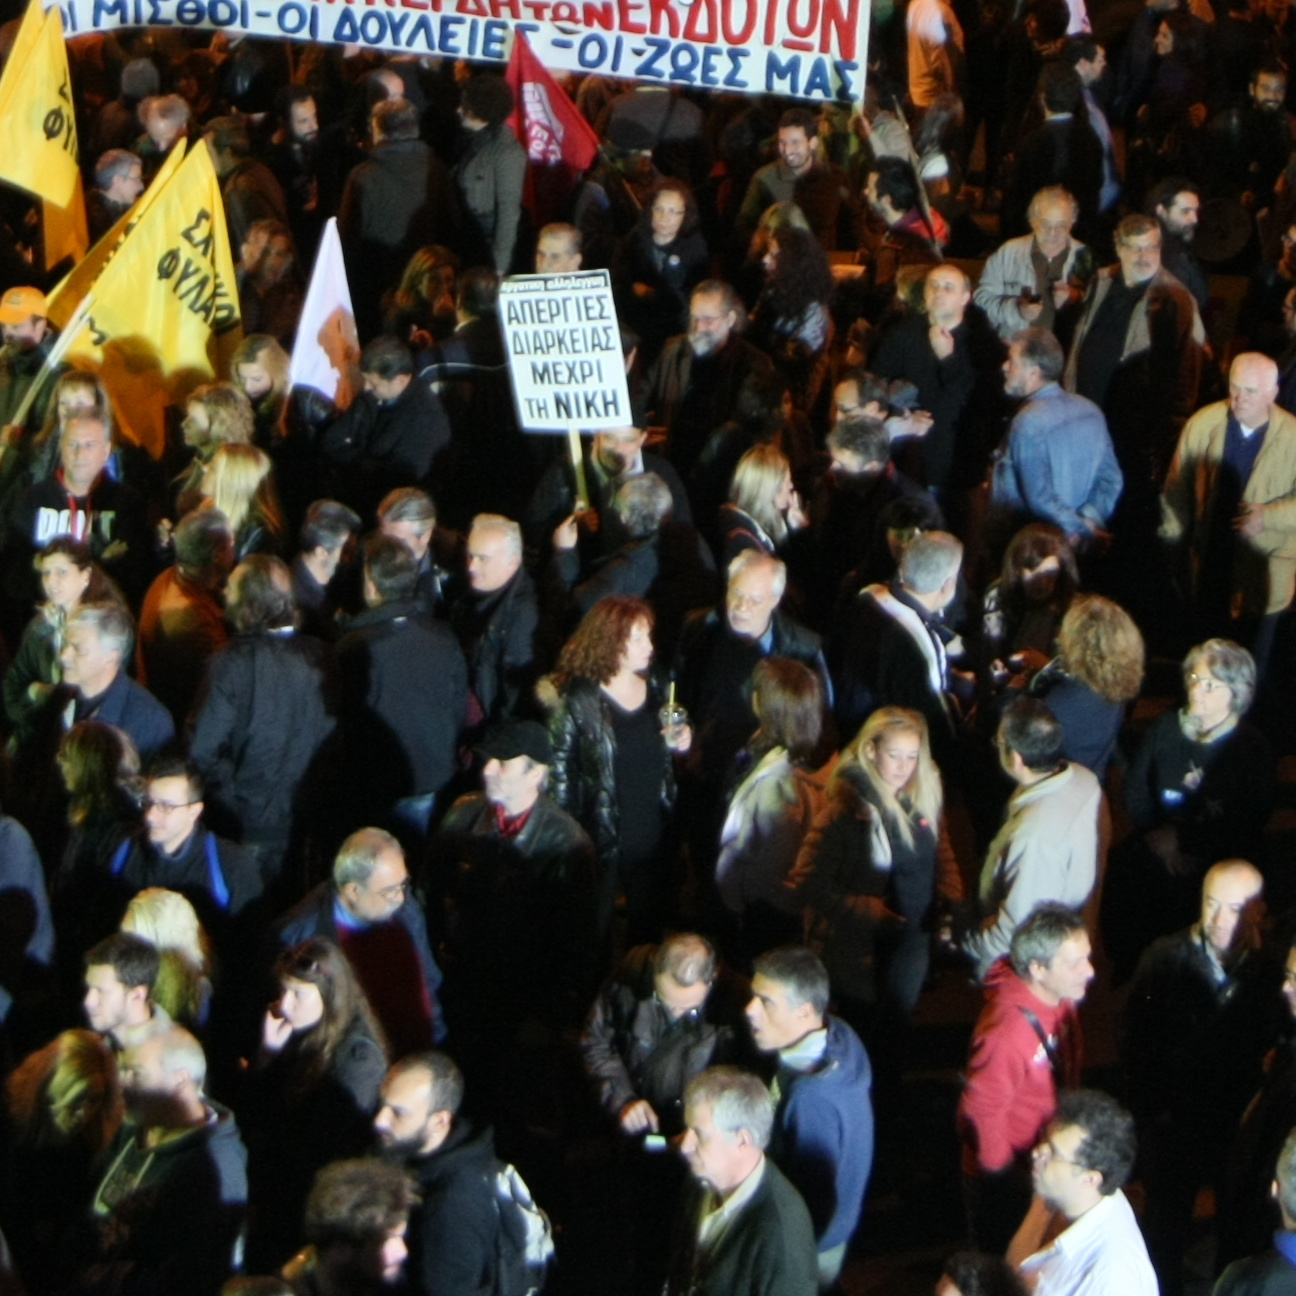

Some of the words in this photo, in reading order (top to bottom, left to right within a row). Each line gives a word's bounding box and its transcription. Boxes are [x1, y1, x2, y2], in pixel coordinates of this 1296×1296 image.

[764, 49, 860, 102] ΜΑΣ
[507, 294, 611, 325] ΑΠΕΡΓΙΕΣ
[512, 325, 616, 355] ΔΙΑΡΚΕΙΑΣ
[530, 359, 604, 385] ΜΕΧΡΙ
[524, 397, 550, 419] ΤΗ
[553, 388, 620, 419] ΝΙΚΗ
